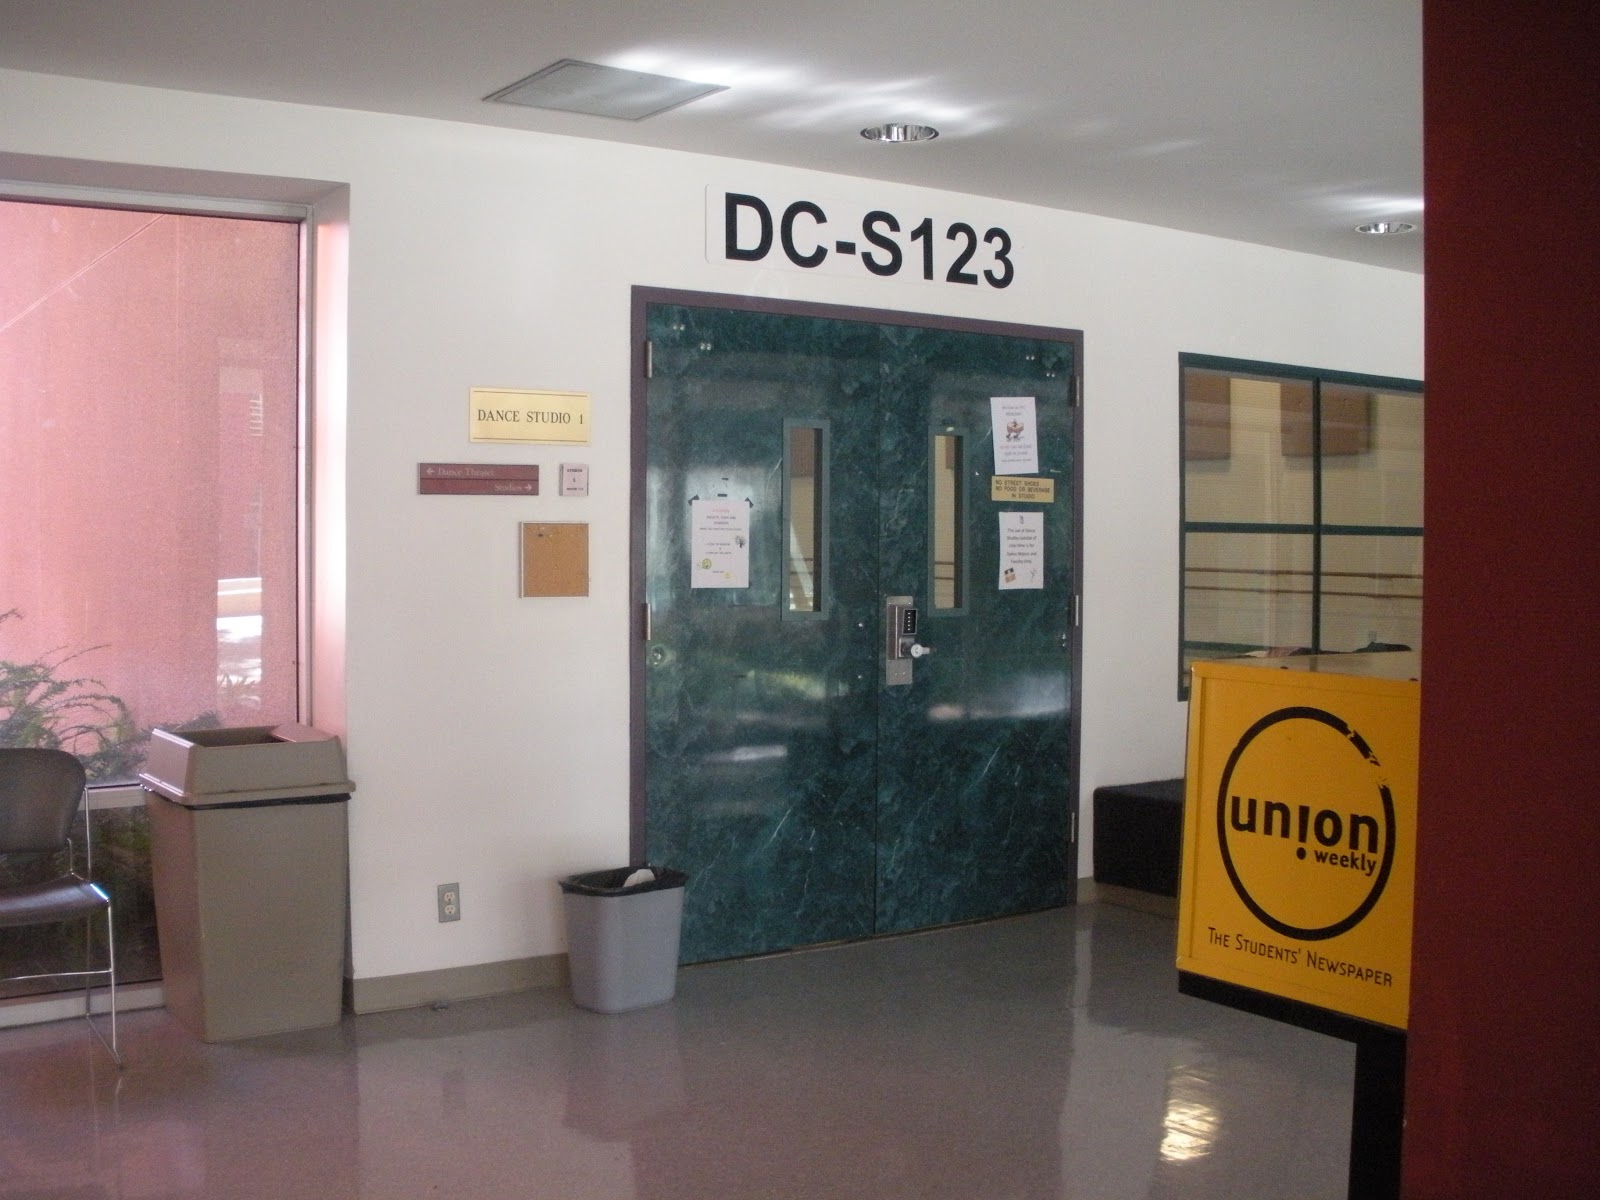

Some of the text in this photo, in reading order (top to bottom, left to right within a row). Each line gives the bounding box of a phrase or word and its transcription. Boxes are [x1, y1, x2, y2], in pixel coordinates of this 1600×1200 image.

[725, 191, 1014, 289] DC-S123
[477, 409, 584, 425] DANCE STUDIO 1
[437, 467, 461, 476] Dance
[1313, 849, 1377, 877] weekly
[1208, 927, 1392, 988] THE STUDENTS' NEWSPAPER
